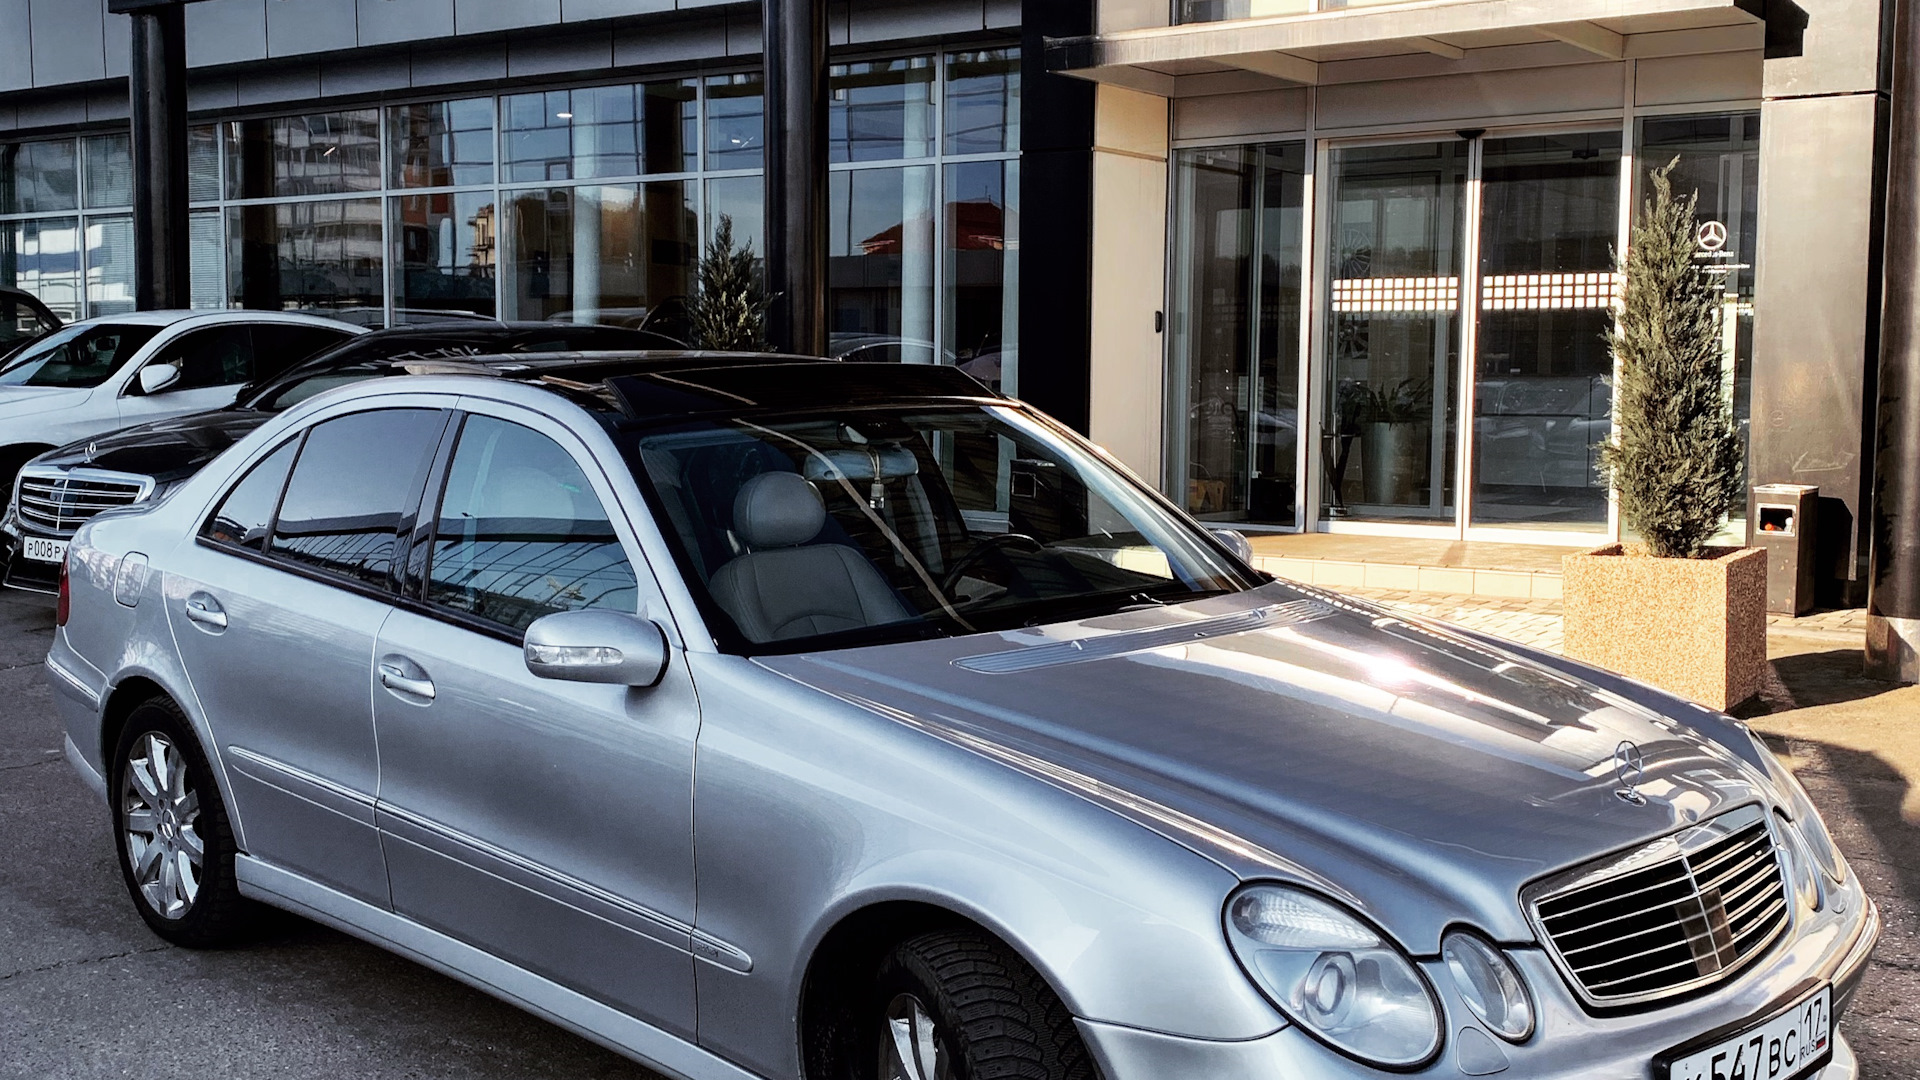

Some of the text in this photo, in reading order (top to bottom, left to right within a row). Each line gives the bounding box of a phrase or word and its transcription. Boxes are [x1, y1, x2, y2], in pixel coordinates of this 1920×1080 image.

[1804, 997, 1822, 1041] 17
[1686, 1029, 1797, 1080] 547BC
[1800, 1039, 1816, 1061] RUS
